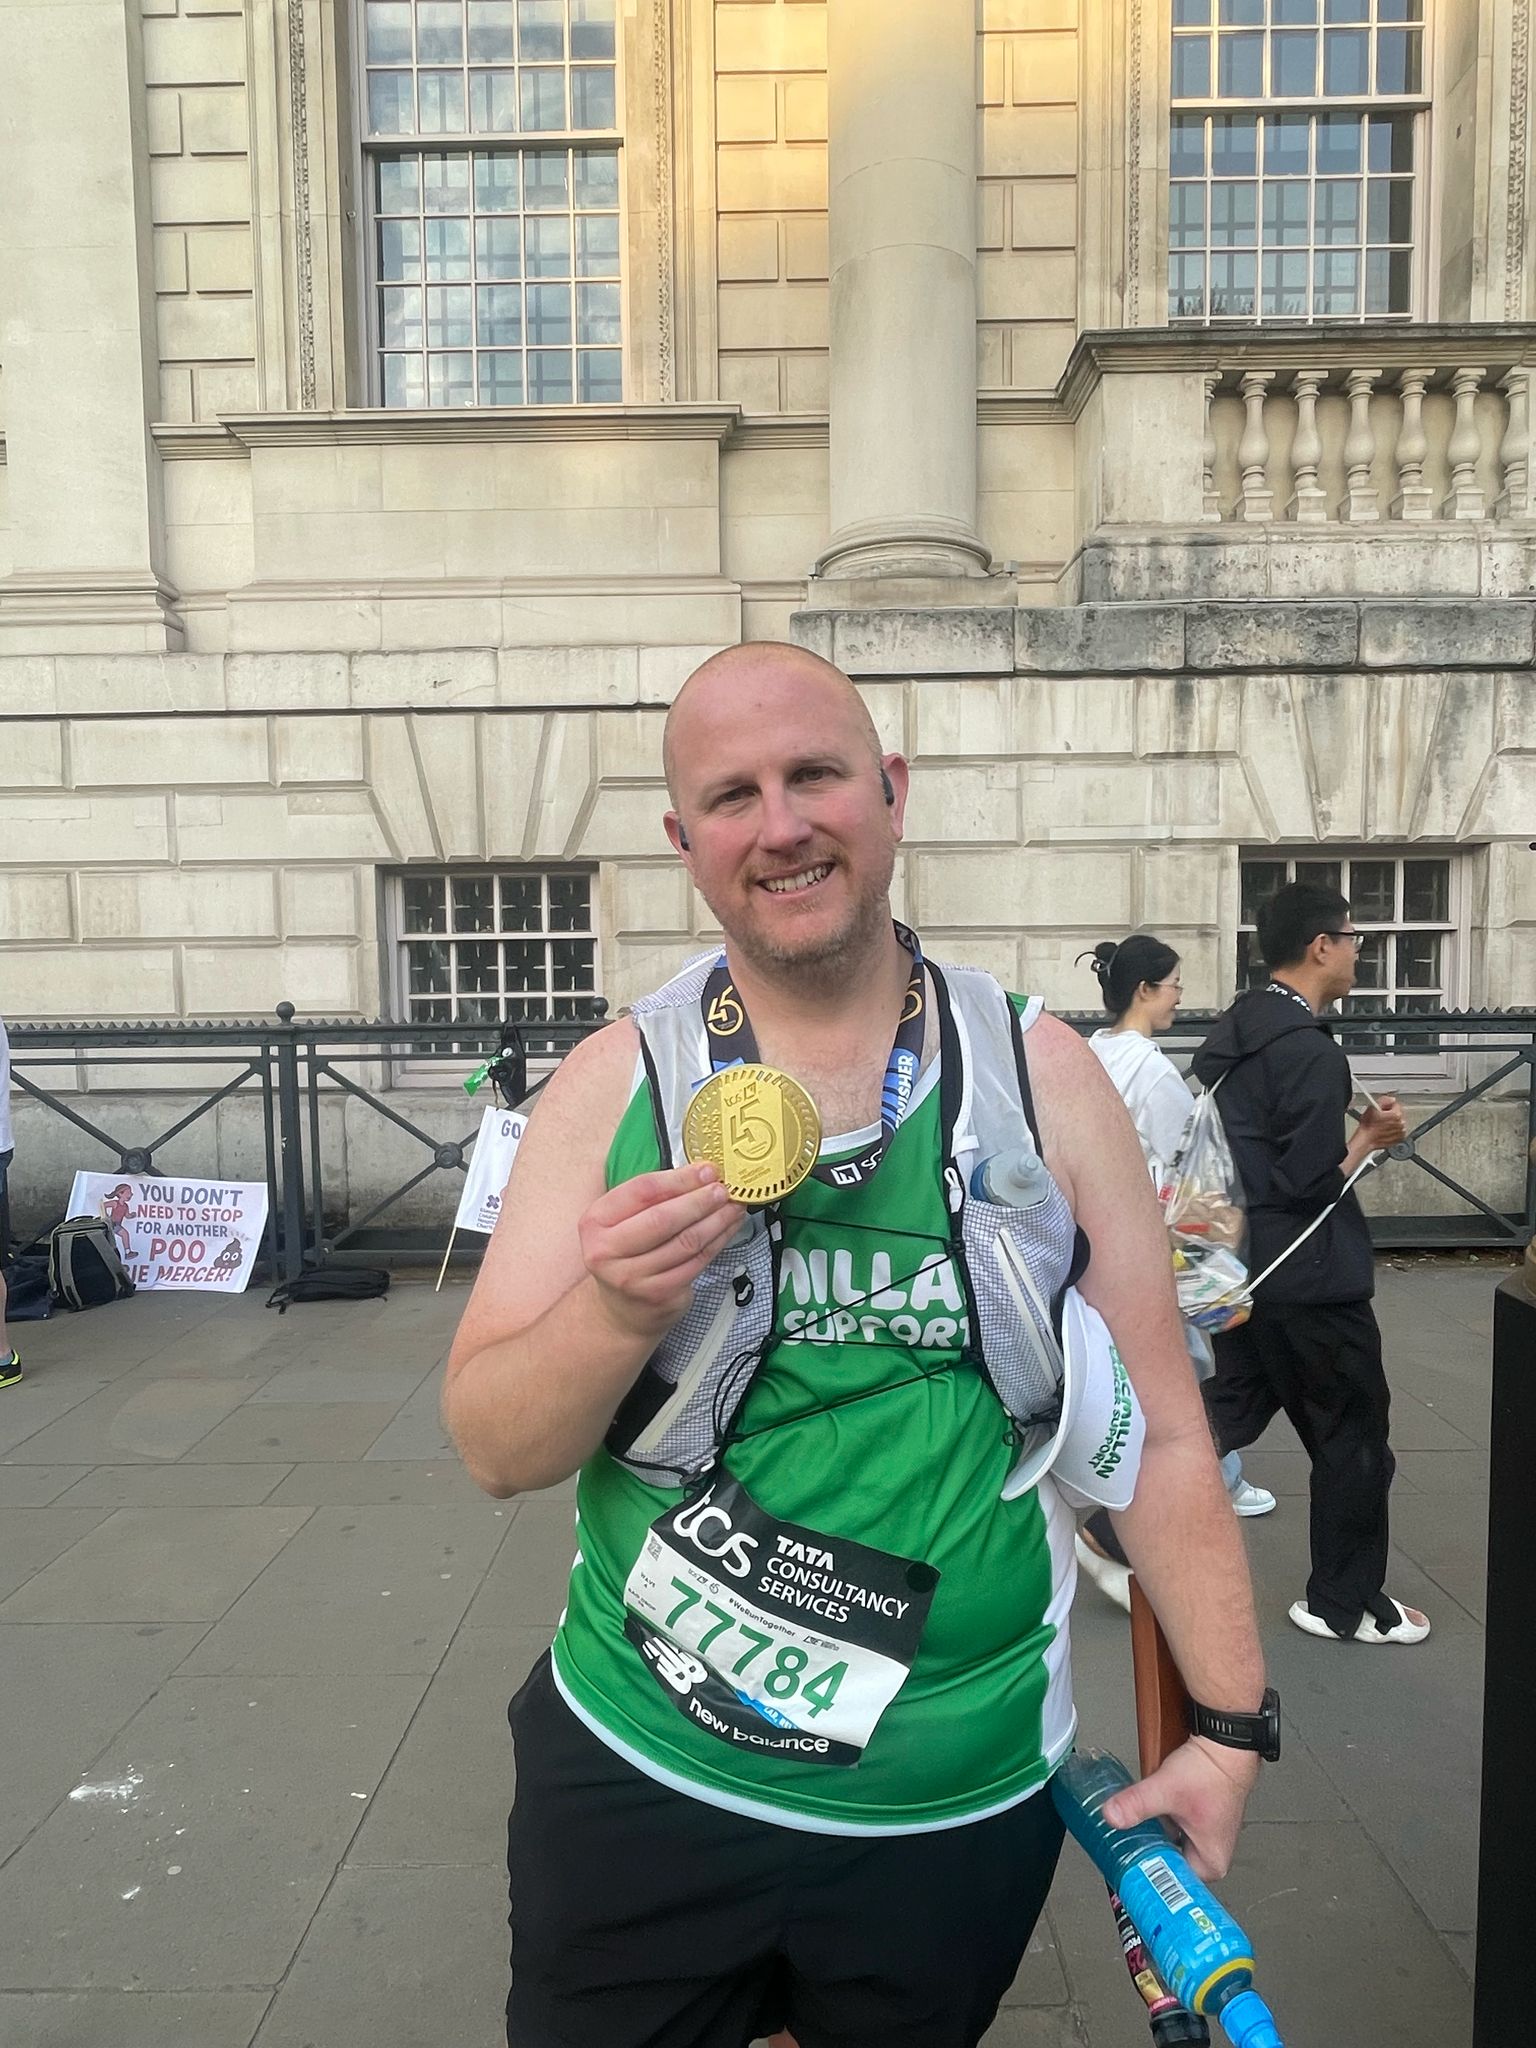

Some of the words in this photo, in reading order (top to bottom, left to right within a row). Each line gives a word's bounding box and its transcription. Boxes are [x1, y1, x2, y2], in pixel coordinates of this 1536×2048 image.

[137, 1204, 174, 1219] NEED
[177, 1207, 196, 1221] TO
[201, 1208, 243, 1222] STOP
[138, 1183, 175, 1203] YOU
[180, 1186, 243, 1207] DON'T
[135, 1221, 162, 1235] FOR
[166, 1224, 228, 1238] ANOTHER
[149, 1238, 206, 1264] POO
[154, 1265, 233, 1283] MERCER!
[1088, 1408, 1121, 1469] SUPPORT
[776, 1535, 835, 1571] TATA
[758, 1576, 851, 1623] SERVICES
[766, 1557, 910, 1620] CONSULTANCY
[665, 1575, 849, 1719] 77784
[689, 1697, 730, 1734] new
